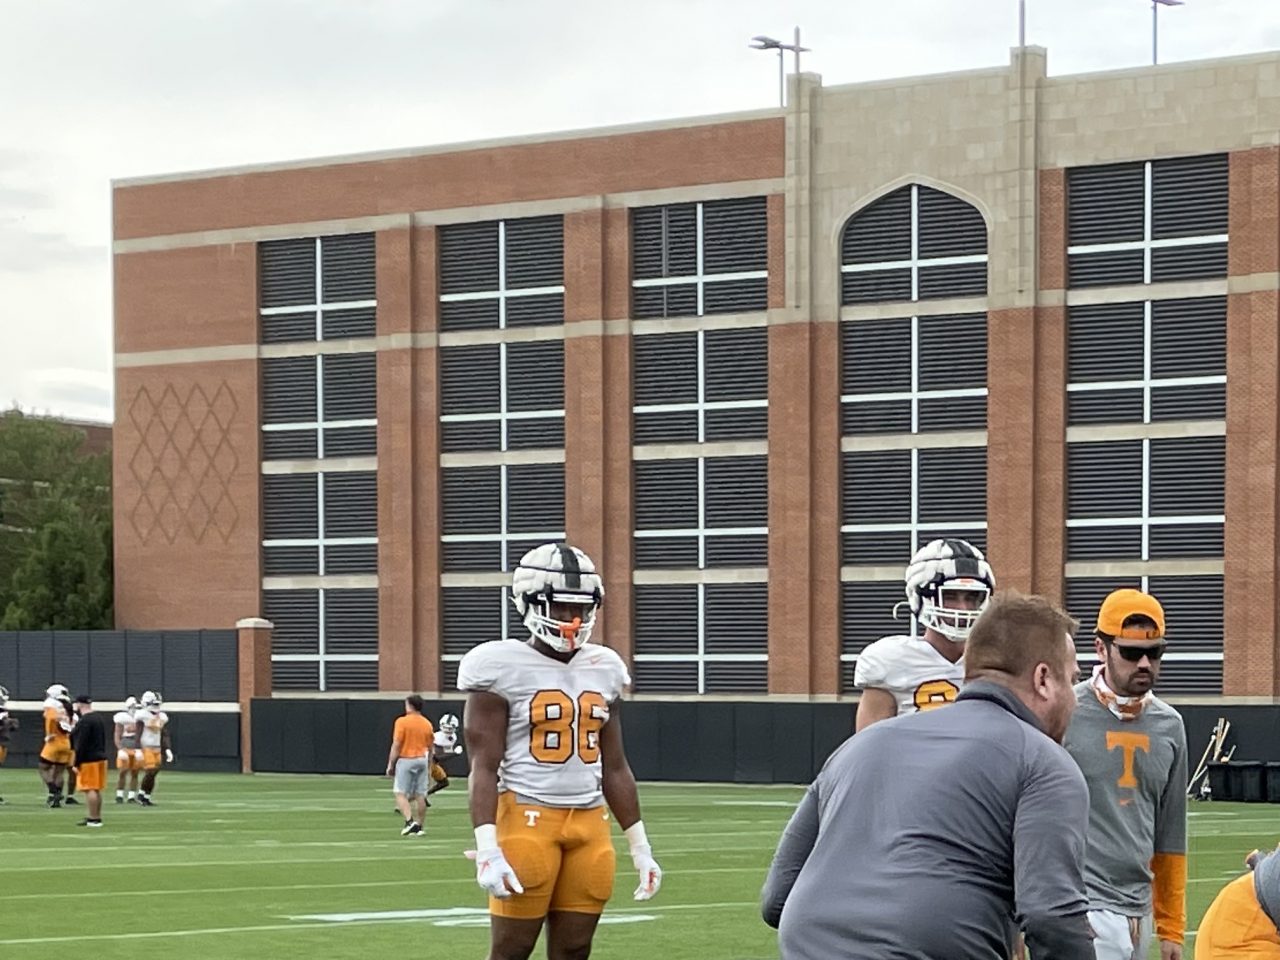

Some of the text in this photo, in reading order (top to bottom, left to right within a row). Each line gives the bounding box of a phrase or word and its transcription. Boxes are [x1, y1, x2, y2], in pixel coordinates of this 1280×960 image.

[529, 689, 609, 764] 86
[1105, 731, 1149, 788] T
[524, 810, 540, 826] T
